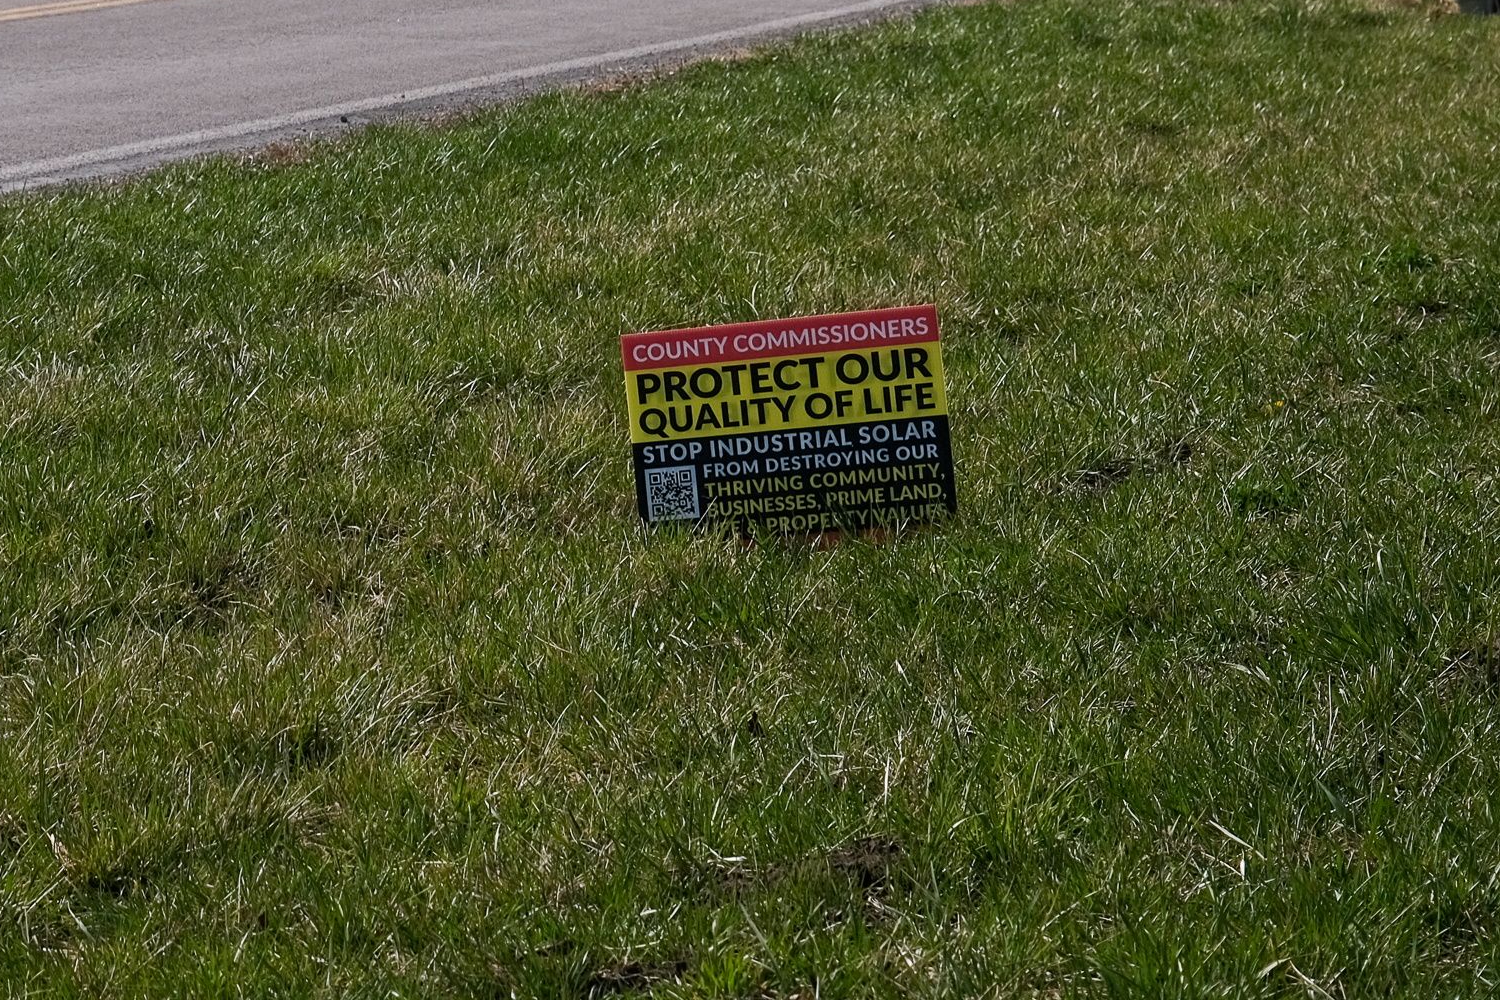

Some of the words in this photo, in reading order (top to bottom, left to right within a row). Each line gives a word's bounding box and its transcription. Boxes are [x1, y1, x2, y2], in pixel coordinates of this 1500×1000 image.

[633, 336, 727, 362] COUNTY
[733, 317, 928, 353] COMMISSIONERS
[636, 357, 824, 404] PROTECT
[836, 348, 932, 385] OUR
[639, 395, 796, 438] QUALITY
[805, 390, 853, 420] OF
[863, 382, 936, 414] LIFE
[643, 442, 702, 464] STOP
[709, 428, 852, 458] INDUSTRIAL
[859, 421, 936, 444] SOLAR
[703, 460, 759, 478] FROM
[766, 448, 889, 473] DESTROYING
[896, 444, 938, 461] OUR
[704, 475, 803, 498] THRIVING
[810, 463, 945, 489] COMMUNITY,
[708, 494, 821, 517] BUSINESSES,
[826, 488, 885, 507] PRIME
[890, 483, 947, 501] LAND,
